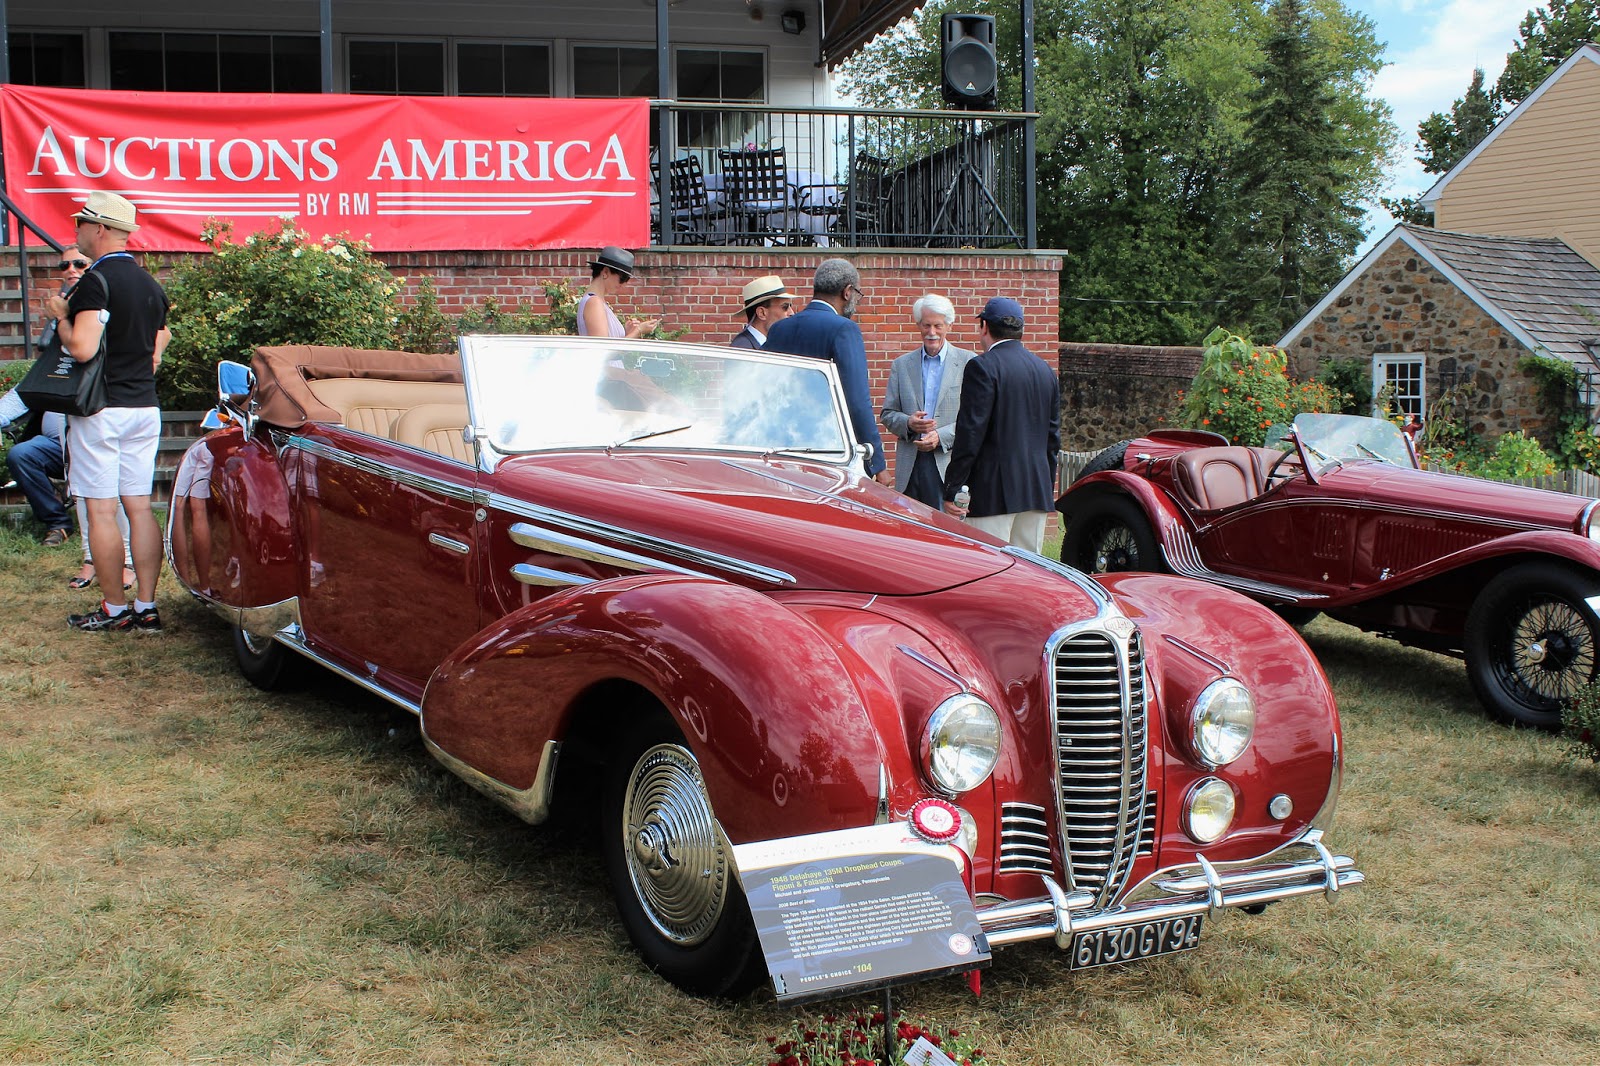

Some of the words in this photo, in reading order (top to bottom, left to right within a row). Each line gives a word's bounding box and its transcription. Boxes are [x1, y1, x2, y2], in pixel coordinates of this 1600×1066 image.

[27, 125, 338, 182] AUCTIONS
[367, 133, 636, 182] AMERICA
[307, 193, 330, 216] BY
[339, 192, 369, 215] RM
[769, 875, 788, 883] 1948
[789, 870, 822, 881] Delahaye
[823, 867, 843, 875] 135M
[844, 862, 878, 873] Drophead
[771, 882, 795, 892] Figoni
[803, 876, 834, 886] Falaschi
